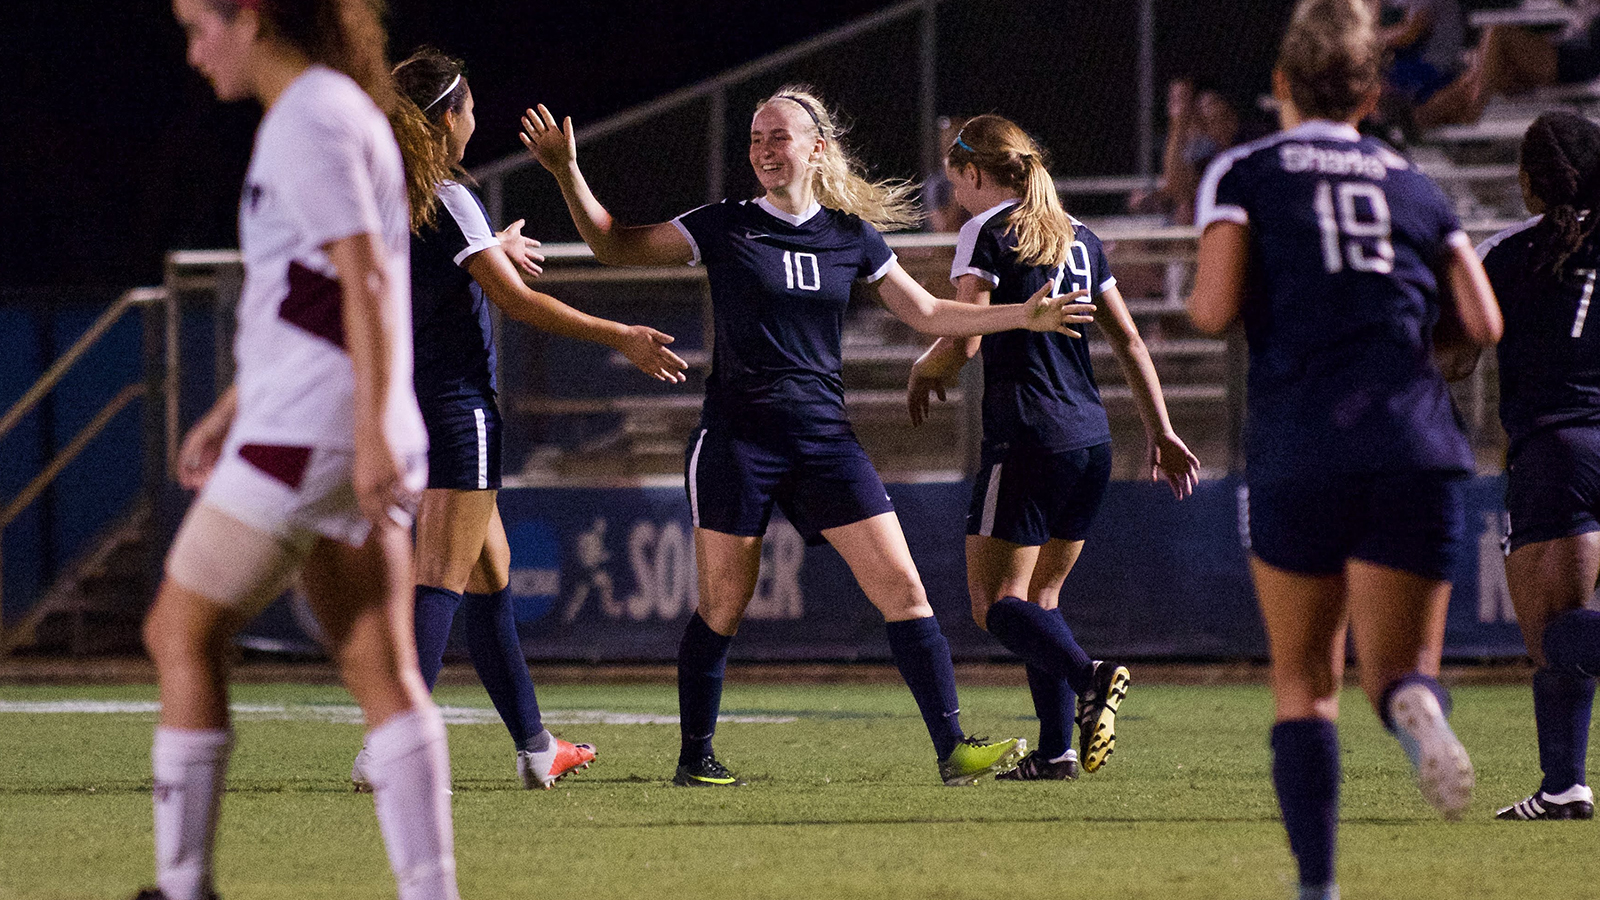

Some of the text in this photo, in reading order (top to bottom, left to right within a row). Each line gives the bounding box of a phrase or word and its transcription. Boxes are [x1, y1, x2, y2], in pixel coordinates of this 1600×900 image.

[1314, 180, 1395, 275] 19
[783, 250, 821, 292] 10
[1571, 268, 1597, 338] 7
[627, 518, 806, 620] SOER
